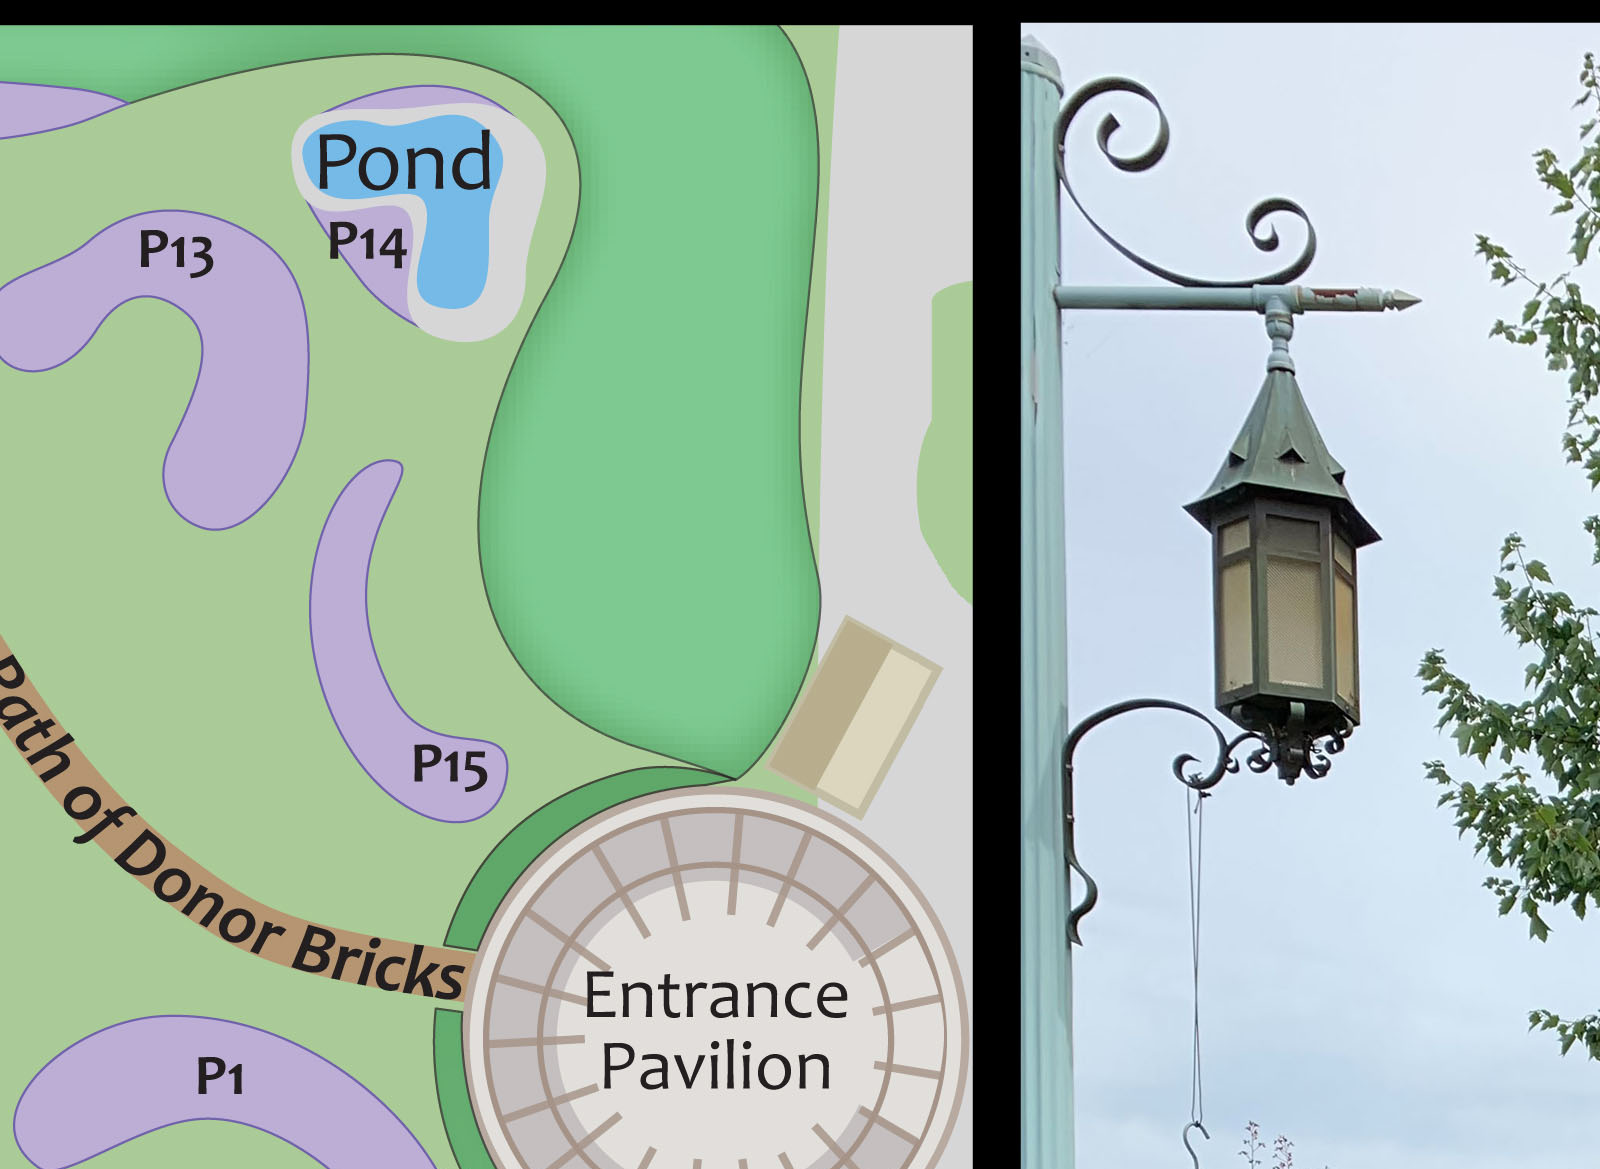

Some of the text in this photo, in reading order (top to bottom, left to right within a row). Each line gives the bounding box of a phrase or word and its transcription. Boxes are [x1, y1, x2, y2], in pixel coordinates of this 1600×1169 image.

[318, 129, 491, 191] Pond
[139, 229, 215, 279] P13
[328, 221, 409, 269] P14
[413, 744, 489, 793] P15
[62, 786, 139, 845] of
[112, 828, 288, 955] Donor
[290, 924, 467, 1000] Bricks
[585, 971, 849, 1019] Entrance
[197, 1056, 244, 1095] P1
[603, 1038, 831, 1090] Pavilion
